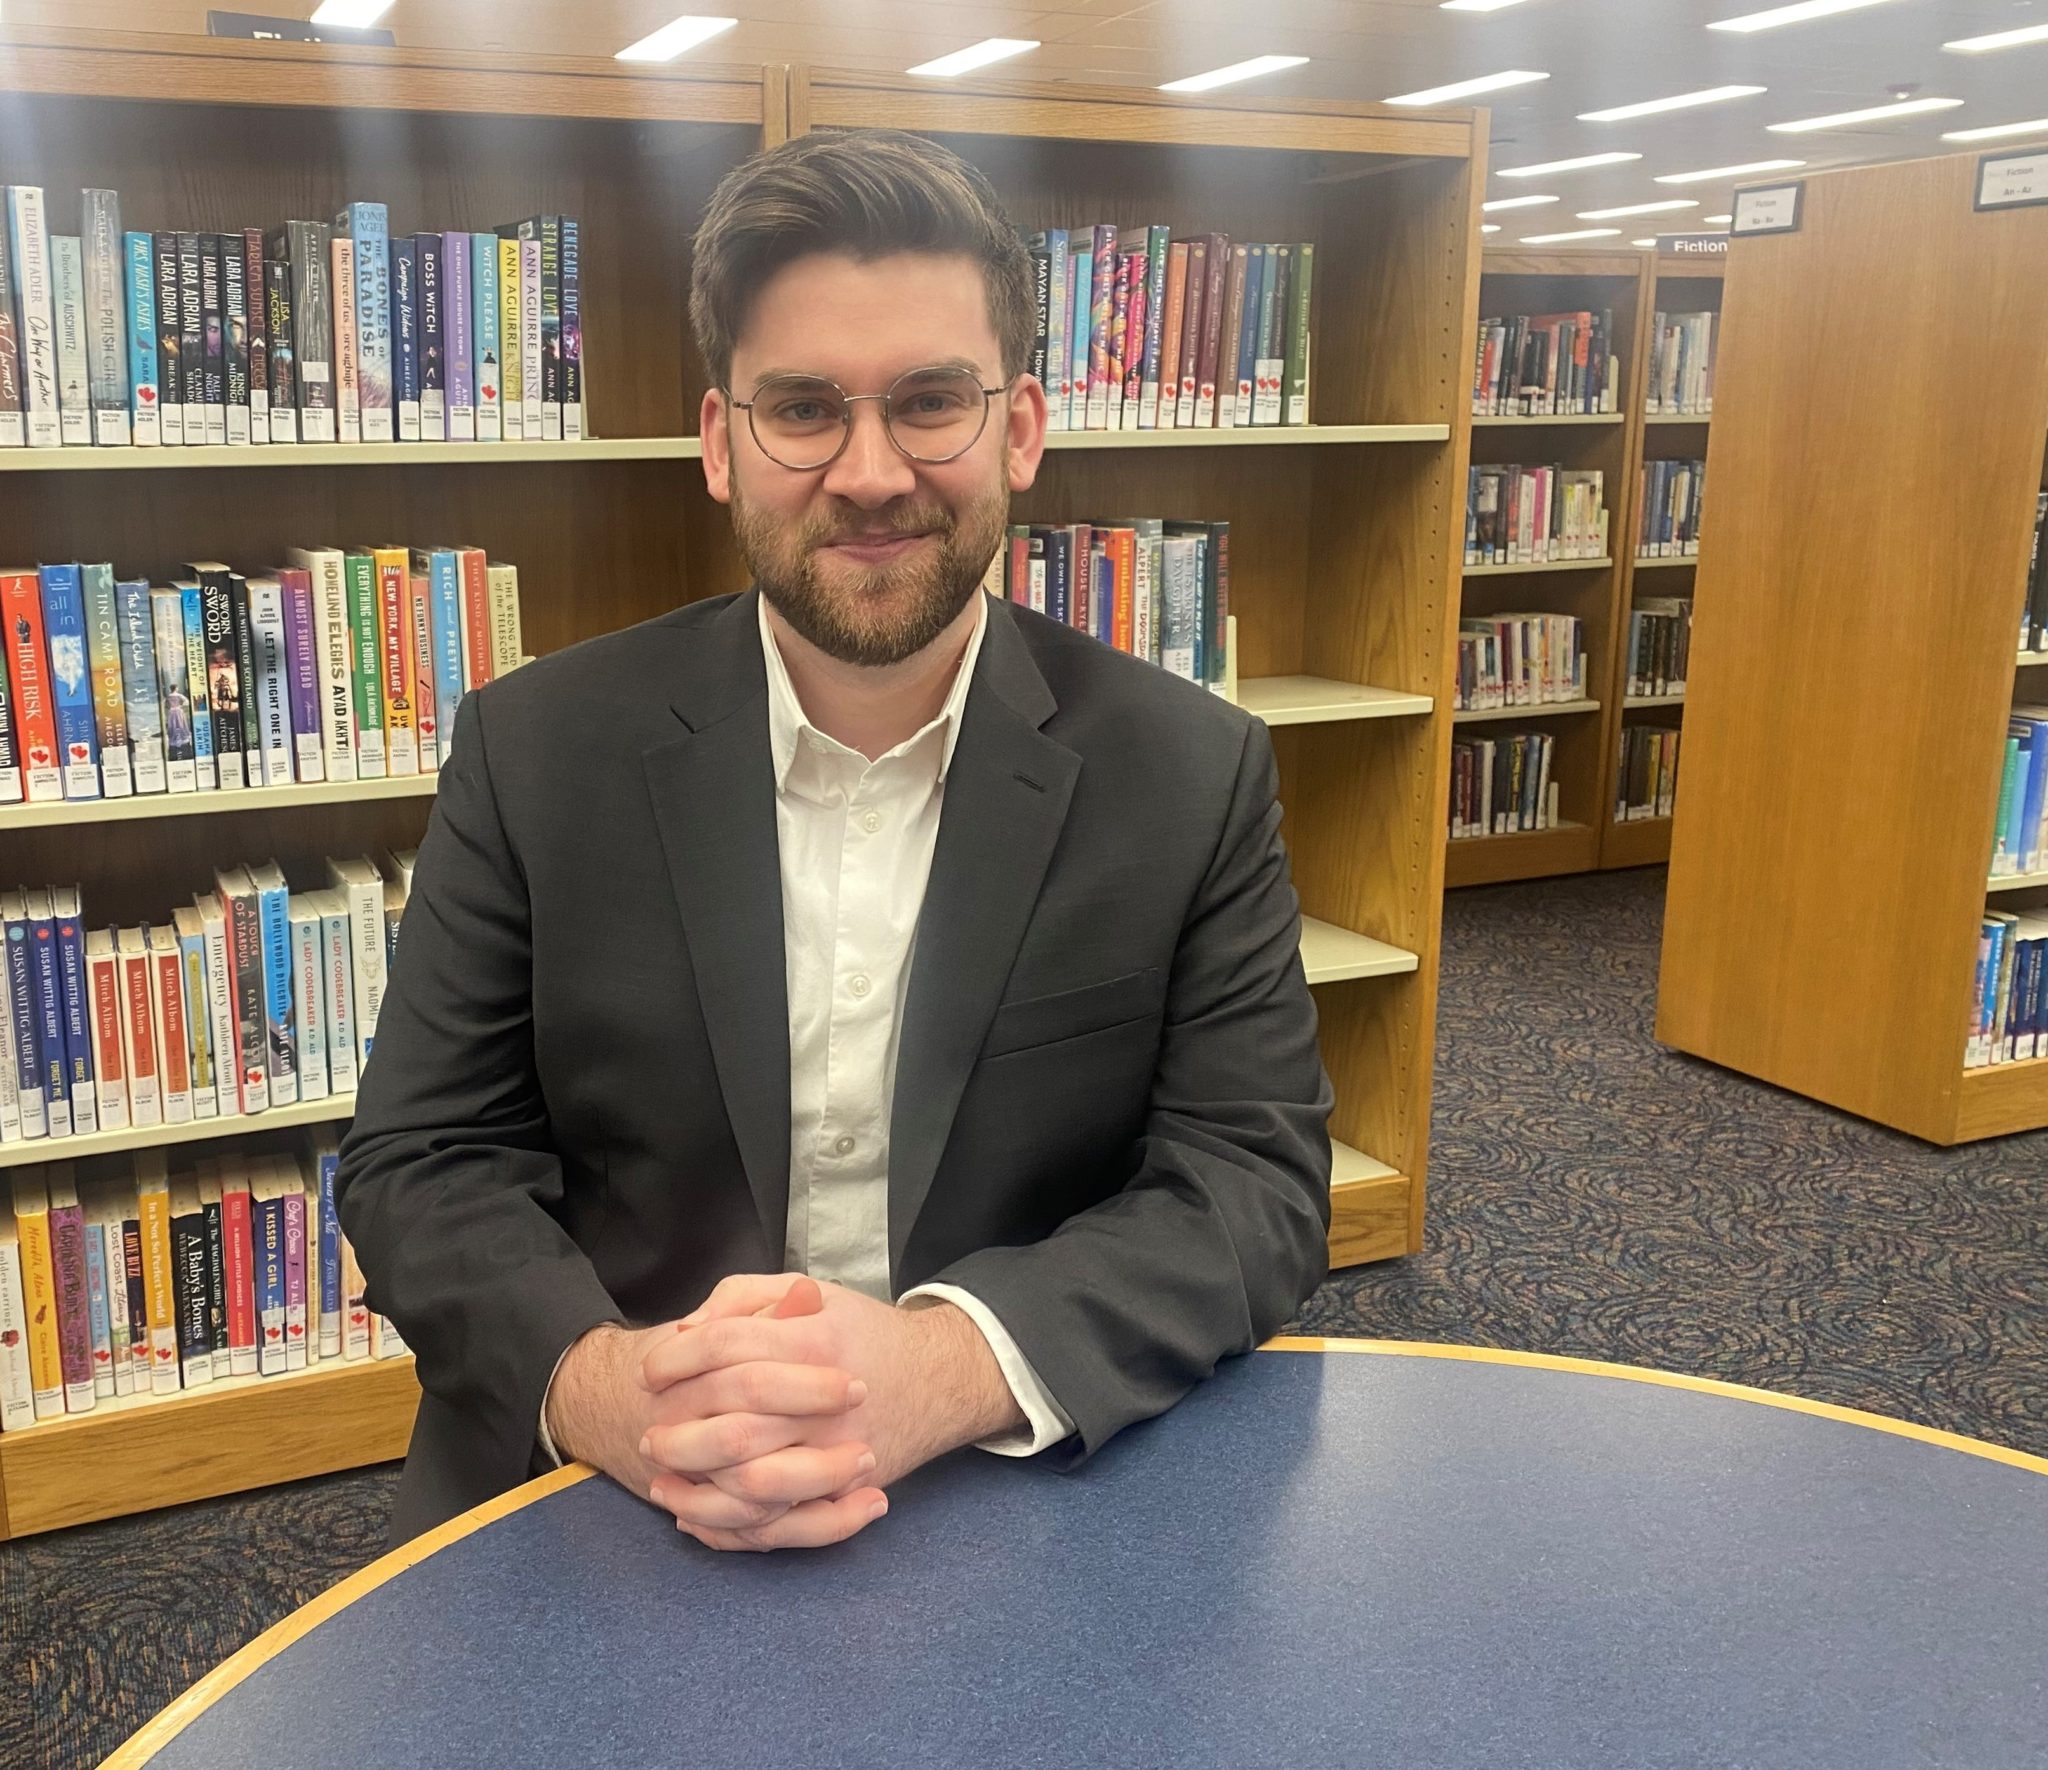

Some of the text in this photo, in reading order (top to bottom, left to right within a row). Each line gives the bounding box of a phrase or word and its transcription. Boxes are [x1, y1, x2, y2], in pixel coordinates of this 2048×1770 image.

[24, 207, 43, 304] ELIZABETH ADLER
[341, 248, 353, 296] the three
[424, 253, 435, 287] BOSS
[506, 246, 517, 278] ANN
[543, 223, 557, 316] STRANGE LOVE
[564, 222, 578, 316] RENEGADE LOVE
[1105, 232, 1113, 262] BLACK
[1674, 240, 1727, 254] Fiction
[161, 254, 178, 325] LARA ADRIAN
[181, 254, 200, 332] LARA ADRIAN
[203, 256, 218, 309] LARA ADRIAN
[225, 256, 243, 316] LARA ADRIAN
[247, 234, 265, 329] HARLEM SUNSET
[269, 287, 281, 335] JACKSON
[280, 301, 290, 321] LISA
[359, 240, 375, 357] PARADISE
[376, 266, 388, 339] BONES
[526, 246, 538, 349] ANN AGUIRRE
[1037, 258, 1047, 337] MAYAN STAR
[101, 309, 115, 352] POLISH
[484, 293, 494, 340] PLEASE
[506, 285, 518, 349] AGUIRRE
[236, 372, 245, 396] KING
[1058, 545, 1065, 560] WE
[1080, 549, 1089, 591] HOUSE
[1138, 547, 1146, 589] ALPERT
[1152, 552, 1159, 567] MY
[50, 597, 68, 611] all
[60, 612, 74, 625] in
[127, 591, 139, 609] The
[204, 586, 222, 644] SWORD
[218, 594, 232, 635] SWORN
[324, 561, 344, 680] HOMELAND ELEGIES
[357, 564, 375, 675] EVERYTHING NOT ENOUGH
[443, 566, 458, 681] RICH PRETTY
[505, 580, 517, 667] THE WRONG END
[1171, 556, 1184, 635] DAUGHTER
[96, 593, 118, 707] TIN CAMP ROAD
[197, 641, 205, 674] WEIGHT
[239, 619, 254, 709] WITCHES SCOTLAND
[264, 631, 274, 650] LET
[267, 653, 277, 674] THE
[294, 588, 313, 688] ALMOST SURELY DEAD
[386, 580, 402, 693] NEW MY VILLAGE
[419, 634, 429, 669] BUSINESS
[475, 630, 484, 672] MOTHER
[497, 613, 508, 667] TELESCOPE
[17, 642, 42, 720] HIGH RISK
[268, 678, 279, 709] RIGHT
[332, 686, 347, 717] AYAD
[196, 727, 204, 750] AIKIN
[228, 727, 236, 751] JAMES
[270, 713, 281, 735] ONE
[235, 902, 249, 968] OF STARDUST
[248, 910, 258, 956] A TOUCH
[362, 897, 376, 953] THE FUTURE
[39, 947, 57, 1039] SUSAN WITTIG ALBERT
[64, 945, 82, 1036] SUSAN WITTIG ALBERT
[211, 935, 227, 1008] Emergency
[272, 917, 286, 1017] HOLLYWOOD DAUGHTER
[303, 941, 316, 1027] LADY CODEBREAKER
[332, 936, 345, 1020] LADY CODEBREAKER
[1991, 930, 2004, 997] MEGAN ANGELO
[12, 946, 35, 1071] SUSAN WITTIG ALBERT
[99, 974, 111, 1038] Mitch Albom
[132, 971, 144, 1035] Mitch Albom
[165, 968, 177, 1032] Mitch Albom
[247, 989, 258, 1018] KATE
[368, 986, 379, 1021] NAOMI
[219, 1015, 232, 1085] Kathleen Alcott
[110, 1225, 123, 1286] Lost Coast
[125, 1231, 141, 1279] LOVE BUZZ
[210, 1228, 218, 1241] The
[266, 1213, 278, 1290] KISSED A GIRL
[286, 1200, 301, 1256] Chef's Choice
[148, 1202, 166, 1319] In Not So Perfect World
[179, 1232, 193, 1347] REBECCA ALEXANDER
[187, 1235, 208, 1339] A Baby's Bones
[1, 1287, 12, 1327] earrings
